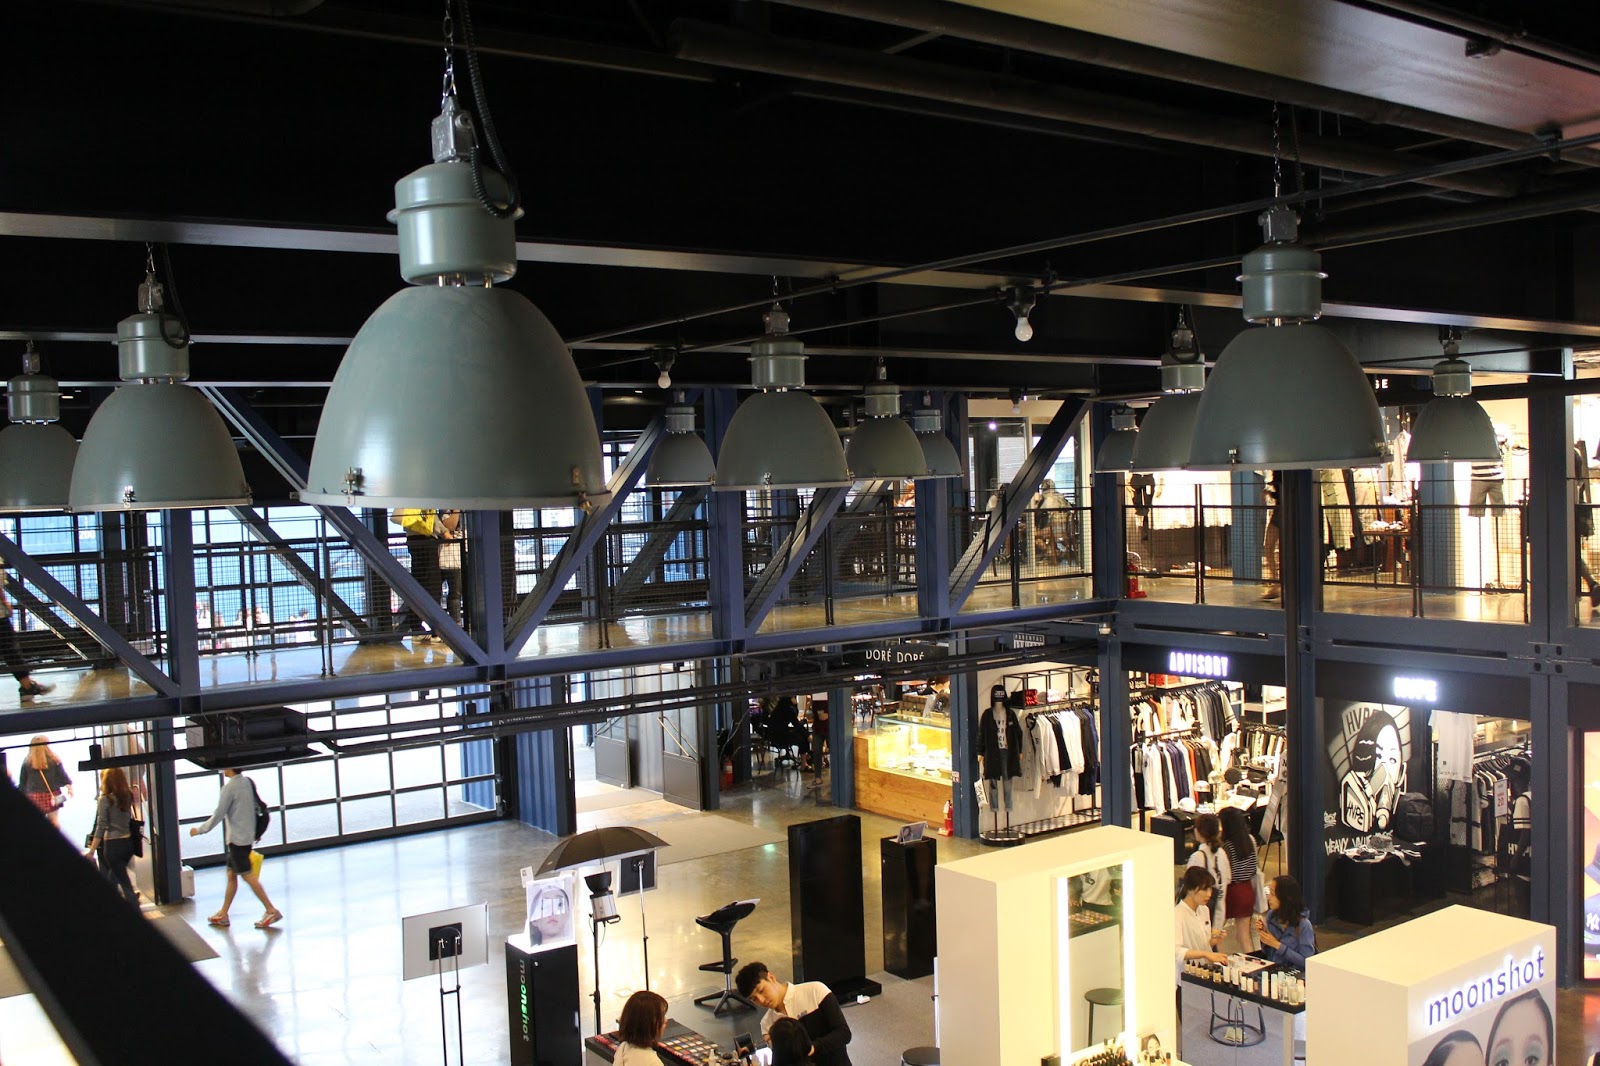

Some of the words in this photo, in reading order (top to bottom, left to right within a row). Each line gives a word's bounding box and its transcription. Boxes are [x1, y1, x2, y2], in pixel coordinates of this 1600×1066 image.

[1169, 651, 1229, 678] ADVISORY
[520, 959, 530, 1042] moonshot
[1428, 948, 1545, 1026] moonshot
